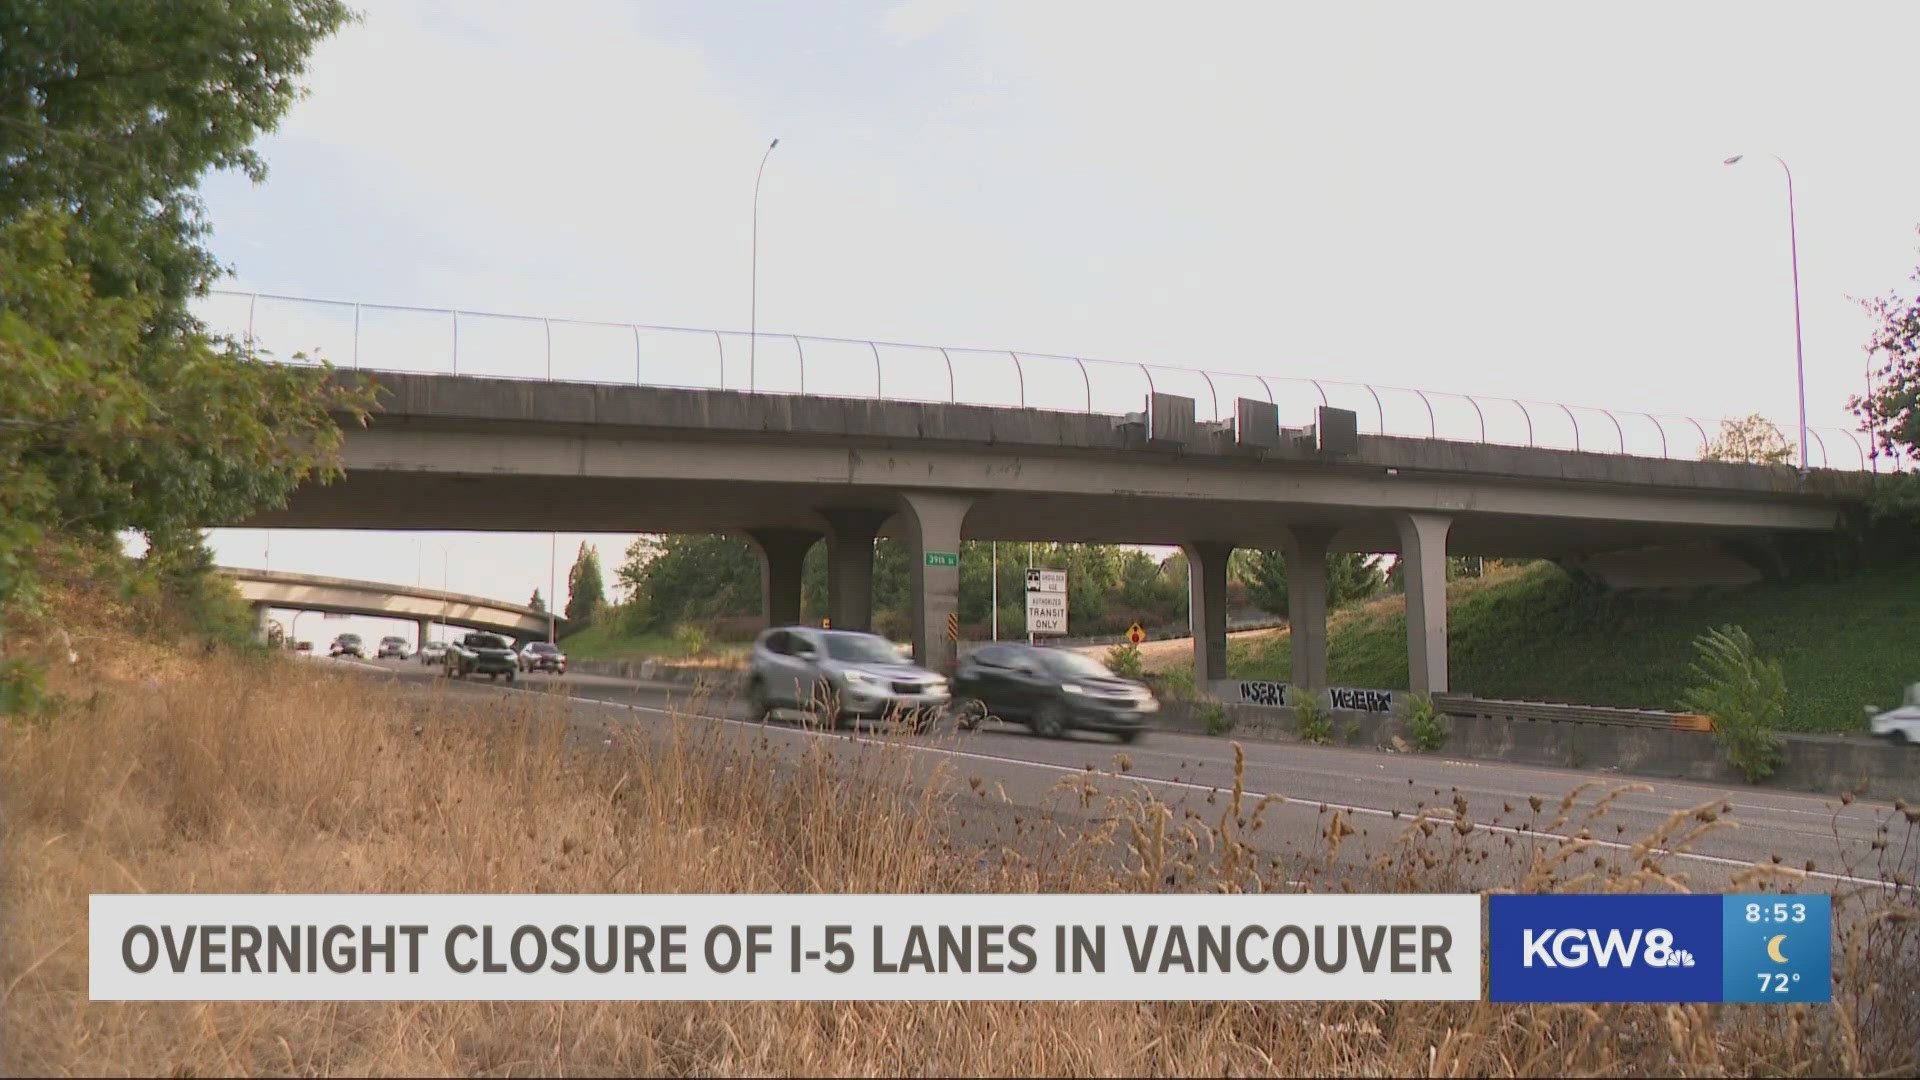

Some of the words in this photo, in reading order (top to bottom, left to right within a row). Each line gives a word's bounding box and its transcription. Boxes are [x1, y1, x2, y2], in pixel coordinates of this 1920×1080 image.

[1032, 598, 1062, 606] AUTHORIZED
[1029, 607, 1065, 618] TRANSIT
[1035, 619, 1058, 629] ONLY
